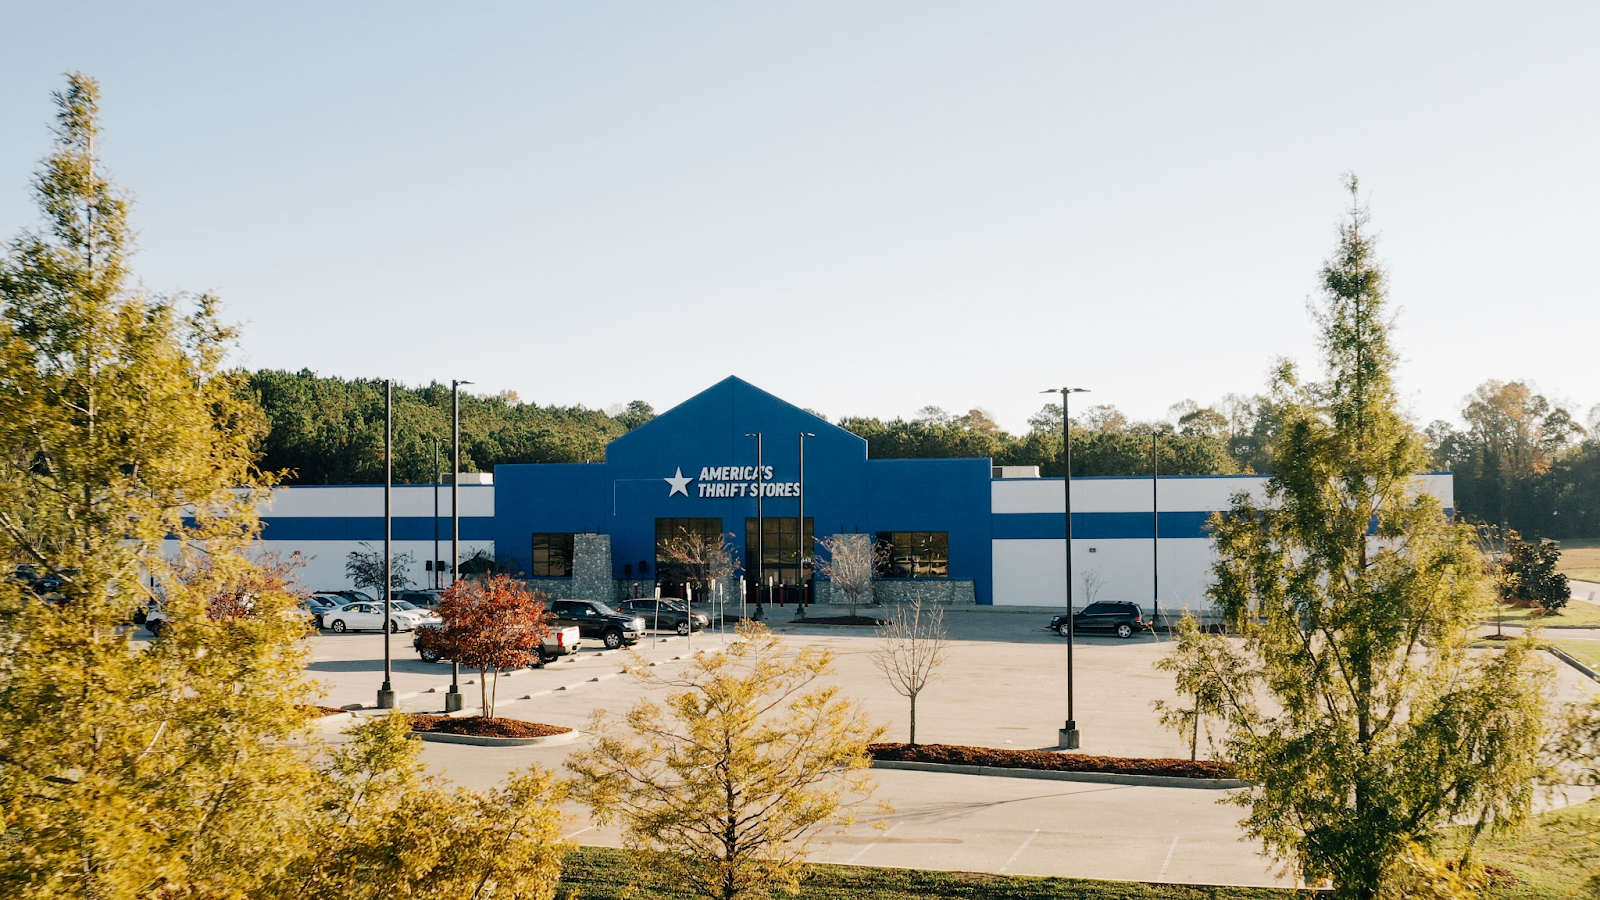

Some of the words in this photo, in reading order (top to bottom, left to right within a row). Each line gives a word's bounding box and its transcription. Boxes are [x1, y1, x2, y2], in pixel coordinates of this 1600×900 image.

[699, 465, 774, 481] AMERICA'S
[698, 483, 748, 497] THRIFT
[750, 482, 800, 497] STORES
